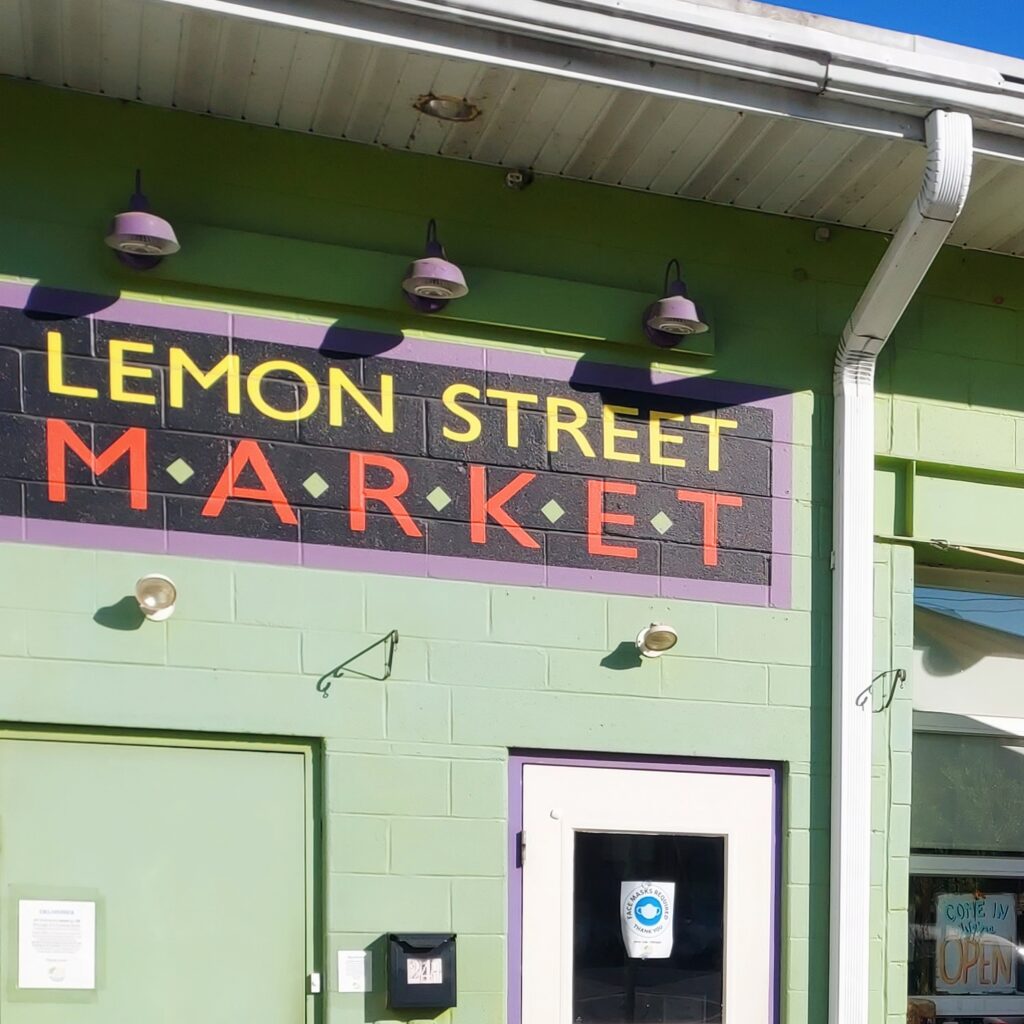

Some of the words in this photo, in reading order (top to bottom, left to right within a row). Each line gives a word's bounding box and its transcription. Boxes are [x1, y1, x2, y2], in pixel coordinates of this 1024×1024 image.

[47, 332, 394, 433] LEMON
[443, 382, 738, 471] STREET
[630, 888, 653, 903] MASKS
[941, 938, 1013, 985] OPEN
